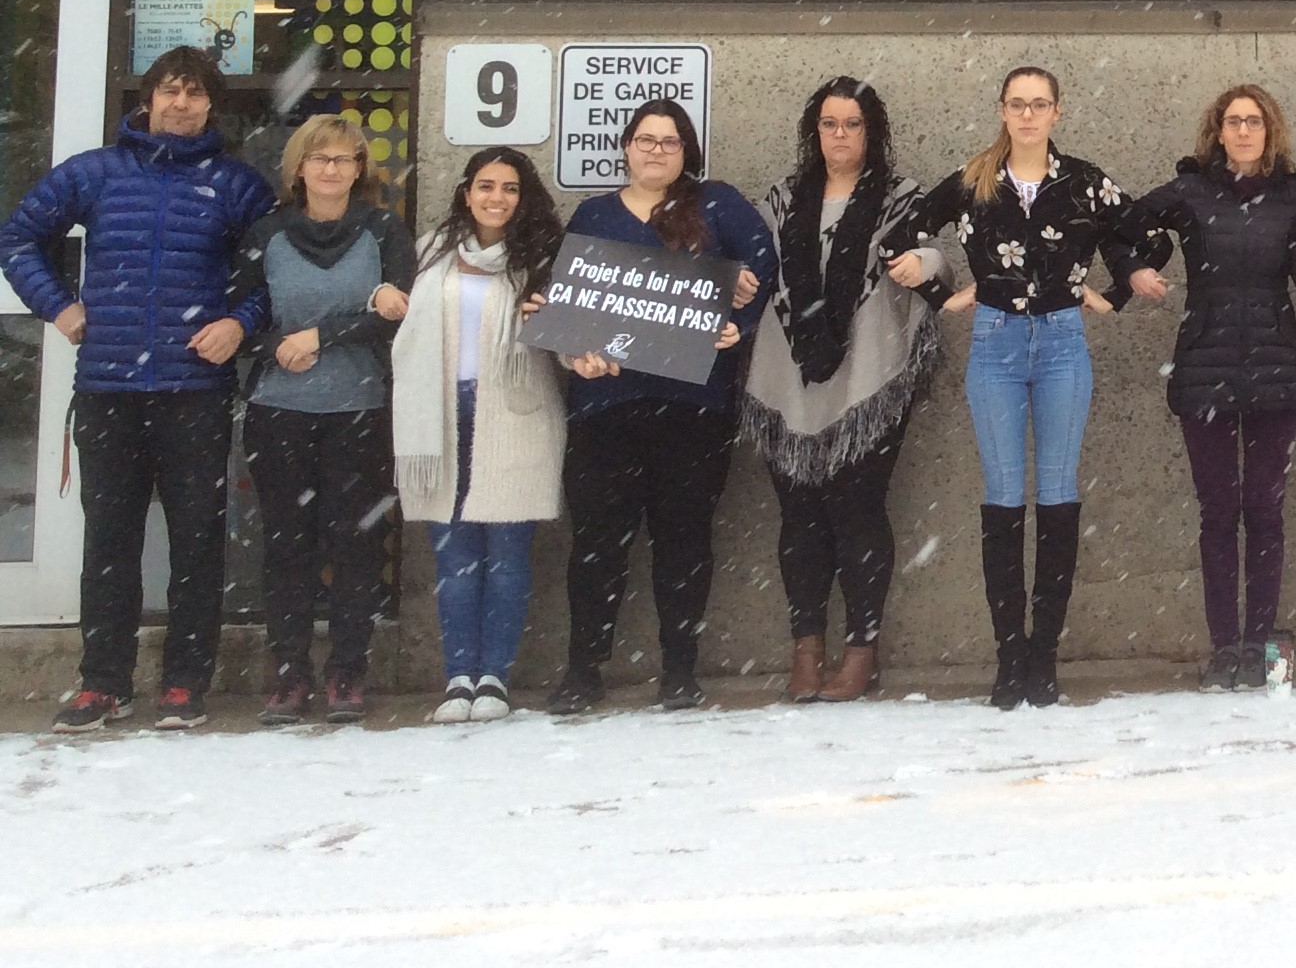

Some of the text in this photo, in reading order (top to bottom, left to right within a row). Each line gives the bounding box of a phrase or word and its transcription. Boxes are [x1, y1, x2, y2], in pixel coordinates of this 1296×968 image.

[585, 56, 684, 75] SERVICE
[476, 60, 519, 129] 9
[573, 82, 694, 101] DE GARDE
[588, 108, 639, 126] ENT
[567, 133, 624, 151] PRIN
[581, 159, 629, 177] POR
[568, 256, 621, 284] Projet
[622, 267, 644, 288] de
[647, 270, 670, 293] loi
[548, 282, 722, 333] ÇA NE PASSERA PAS!
